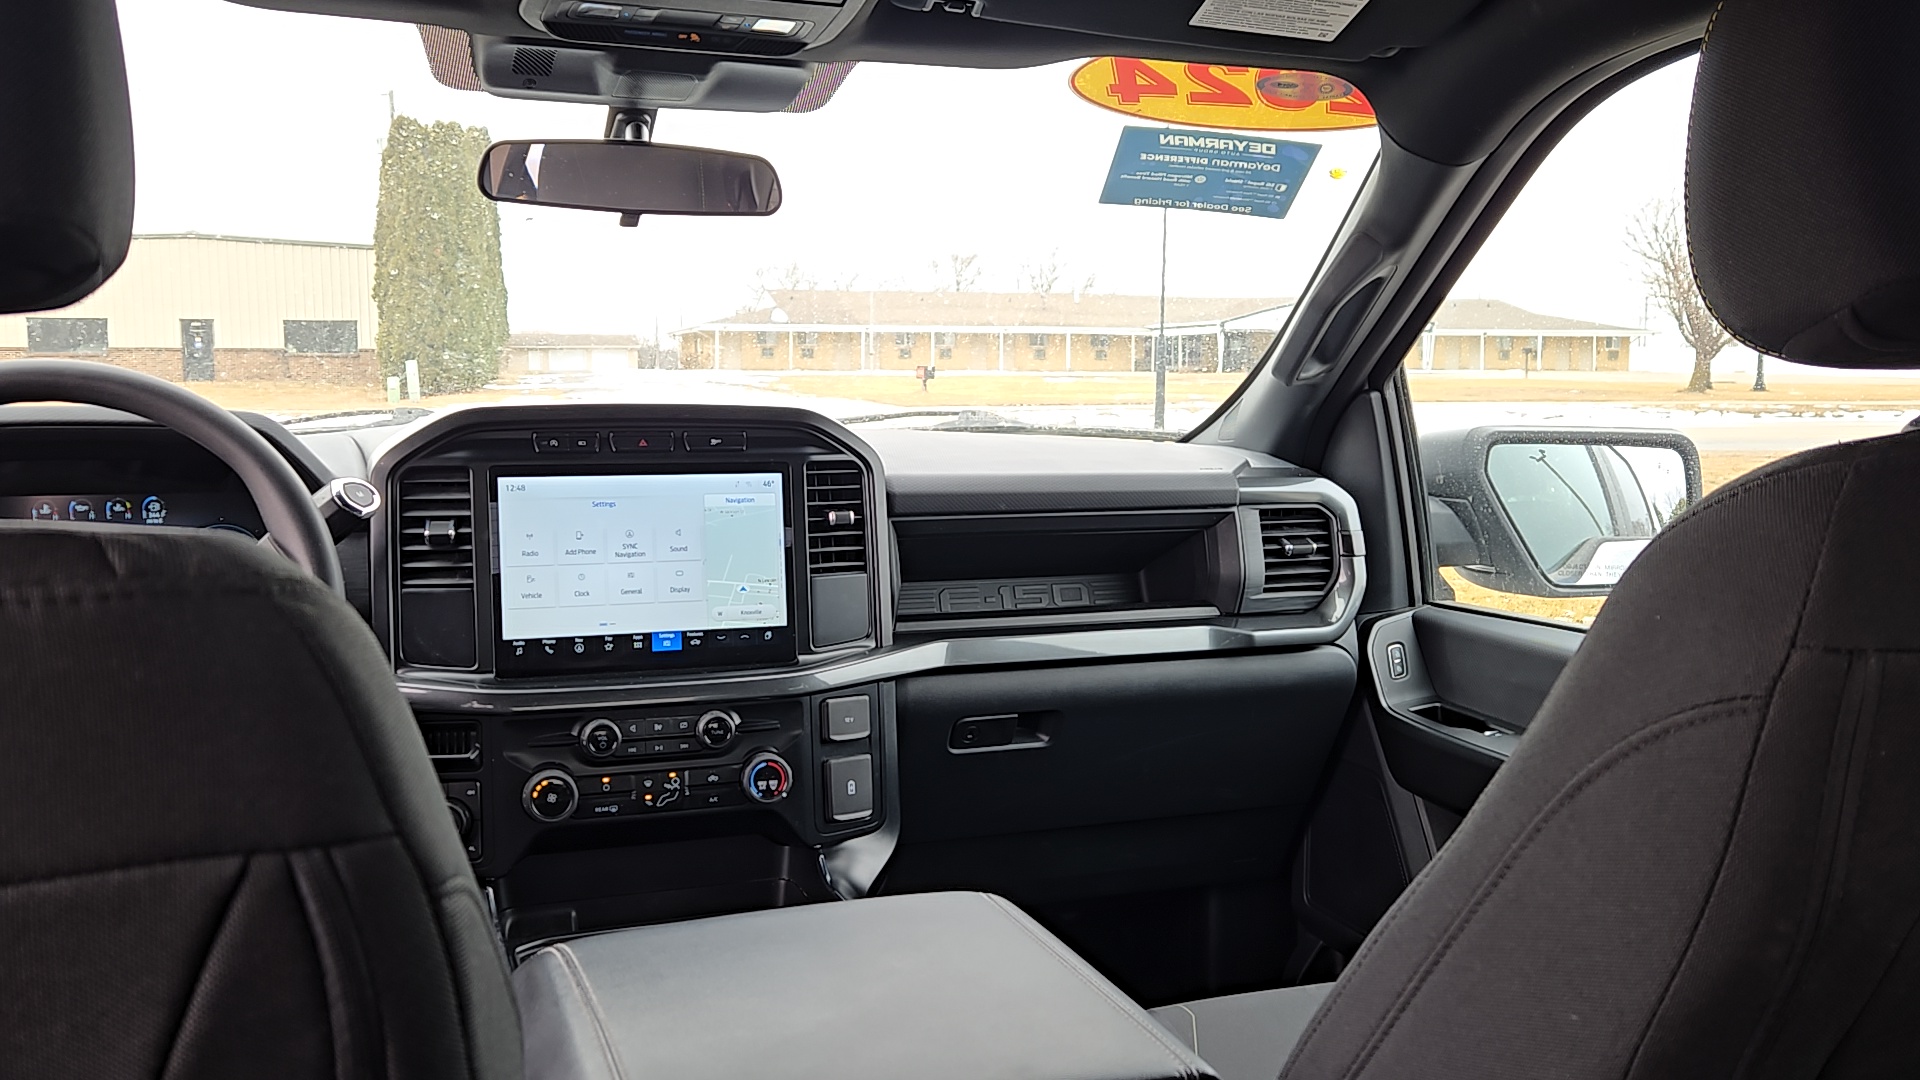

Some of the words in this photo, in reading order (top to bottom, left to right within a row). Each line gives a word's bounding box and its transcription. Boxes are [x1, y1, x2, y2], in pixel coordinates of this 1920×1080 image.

[506, 484, 526, 492] 12:48
[592, 501, 617, 509] Settings
[725, 497, 755, 505] Navigation
[669, 586, 690, 594] Display
[938, 583, 1091, 612] F-150
